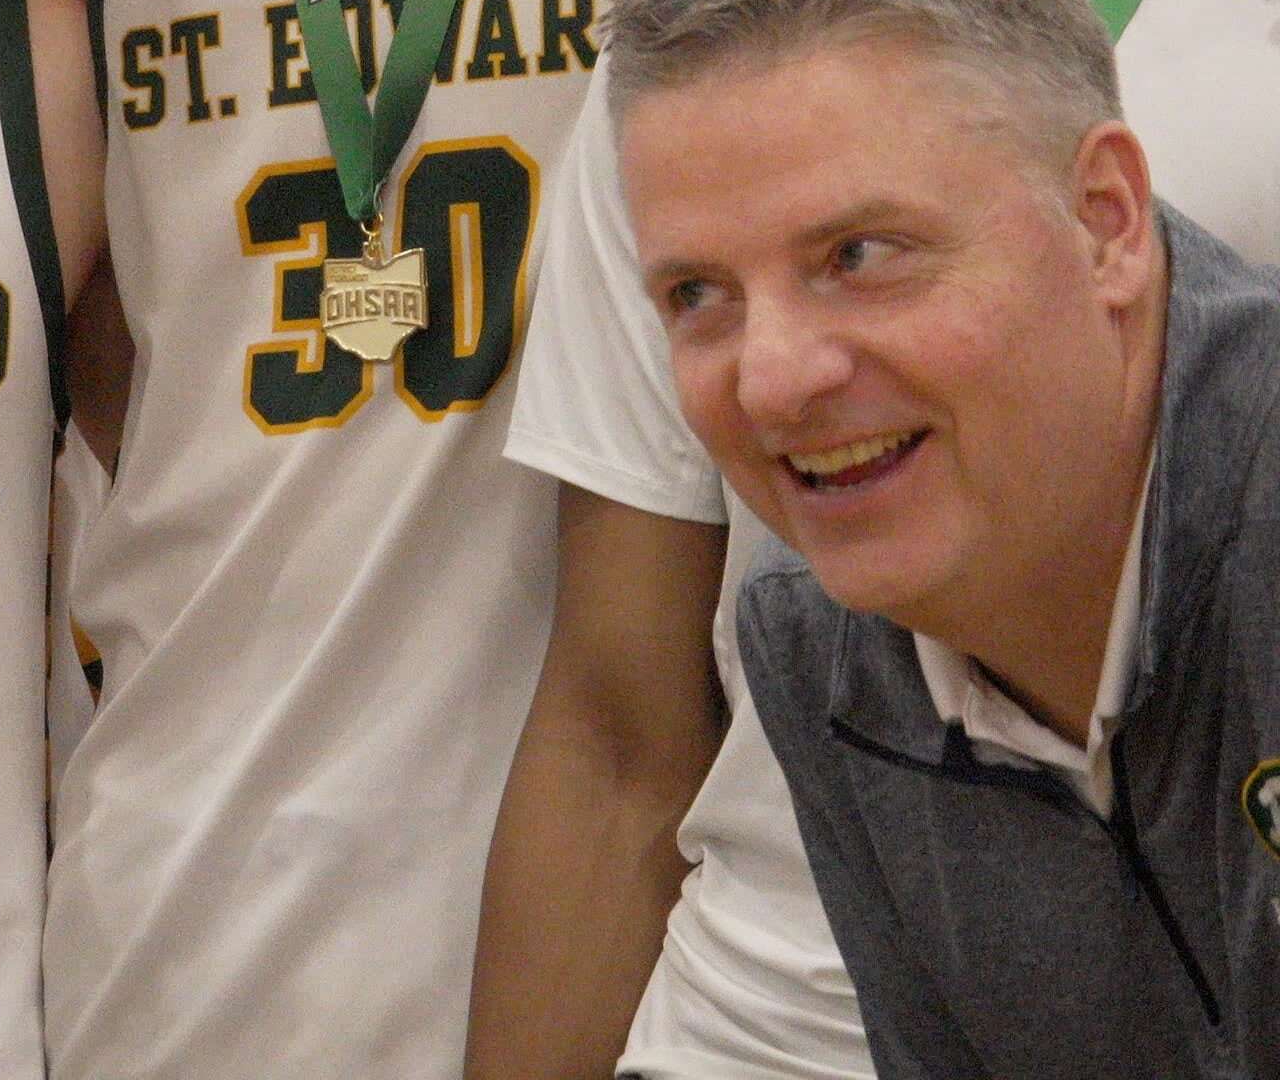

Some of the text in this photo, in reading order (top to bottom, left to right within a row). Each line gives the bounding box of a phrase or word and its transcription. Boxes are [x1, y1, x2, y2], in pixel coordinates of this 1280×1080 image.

[120, 11, 239, 133] ST.
[236, 136, 541, 435] 30
[325, 288, 418, 322] OHSAA
